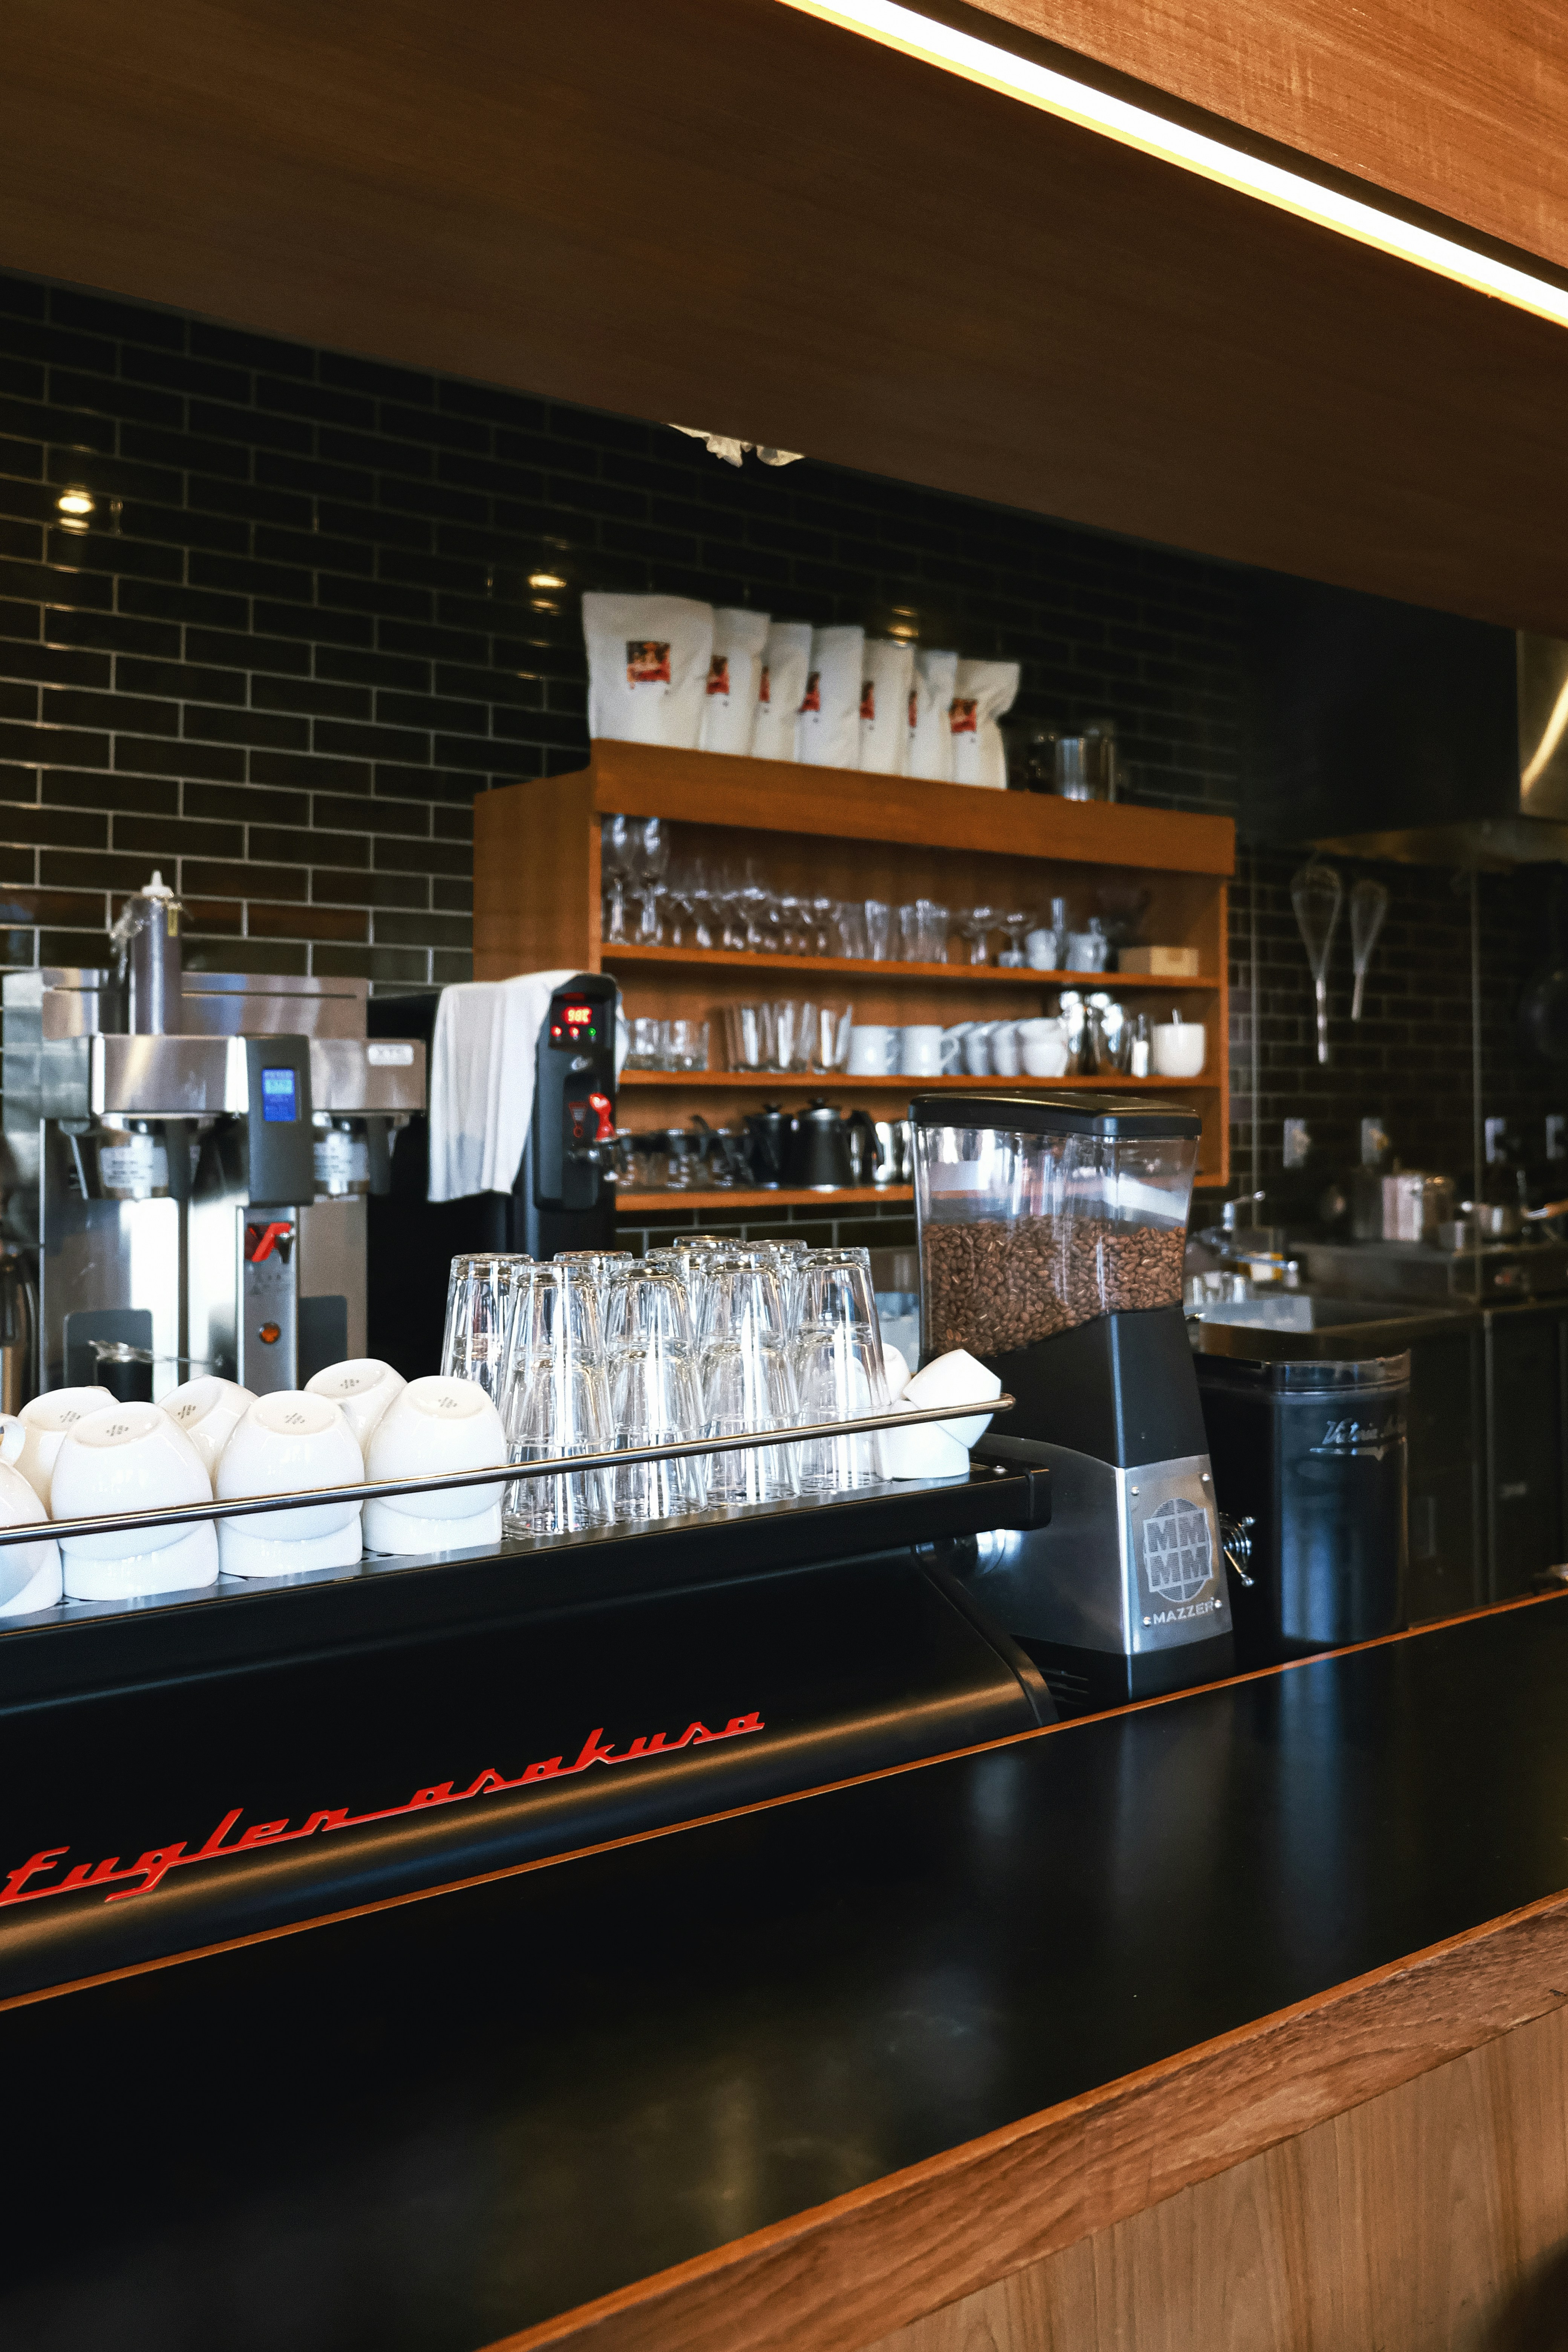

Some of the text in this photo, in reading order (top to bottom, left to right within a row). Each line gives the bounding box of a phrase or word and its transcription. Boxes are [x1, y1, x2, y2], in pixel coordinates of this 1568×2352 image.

[1153, 1600, 1214, 1625] MAZZER
[0, 1712, 765, 1906] fuglen asakusa
